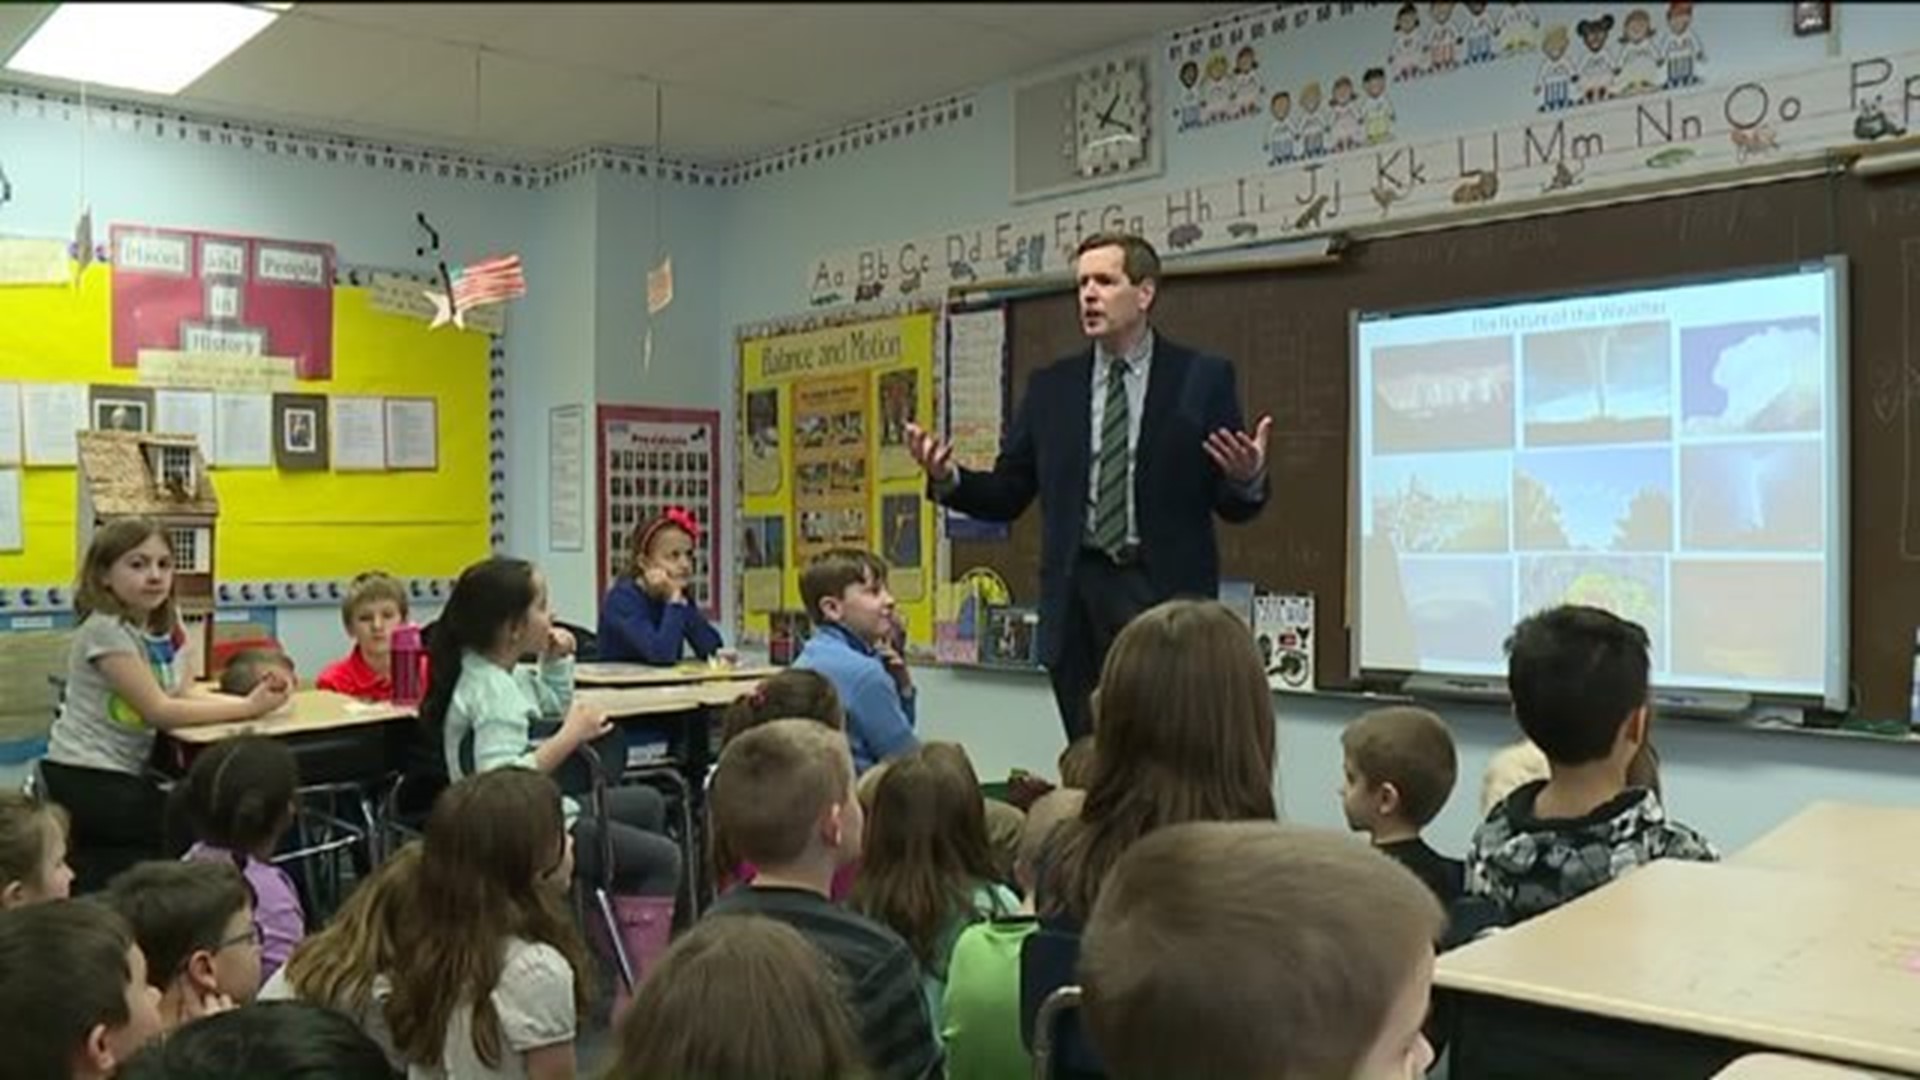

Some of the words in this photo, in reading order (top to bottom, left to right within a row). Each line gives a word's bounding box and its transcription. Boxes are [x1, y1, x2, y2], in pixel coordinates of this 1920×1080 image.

[811, 261, 844, 292] Aa
[859, 249, 889, 282] Bb
[899, 242, 930, 275] Cc
[947, 231, 982, 268] Dd
[1055, 210, 1088, 249] Ff
[1167, 184, 1212, 227] Hh
[1376, 146, 1427, 189] Kk
[1525, 118, 1604, 169] Mm
[1636, 98, 1703, 148] Nn
[1724, 82, 1801, 130] Oo
[264, 254, 320, 279] People
[1499, 311, 1549, 331] Nature
[1550, 307, 1569, 326] of
[1597, 300, 1667, 321] Weather
[192, 332, 256, 355] History
[761, 345, 814, 378] Balance
[818, 336, 848, 367] and
[850, 328, 902, 362] Motion
